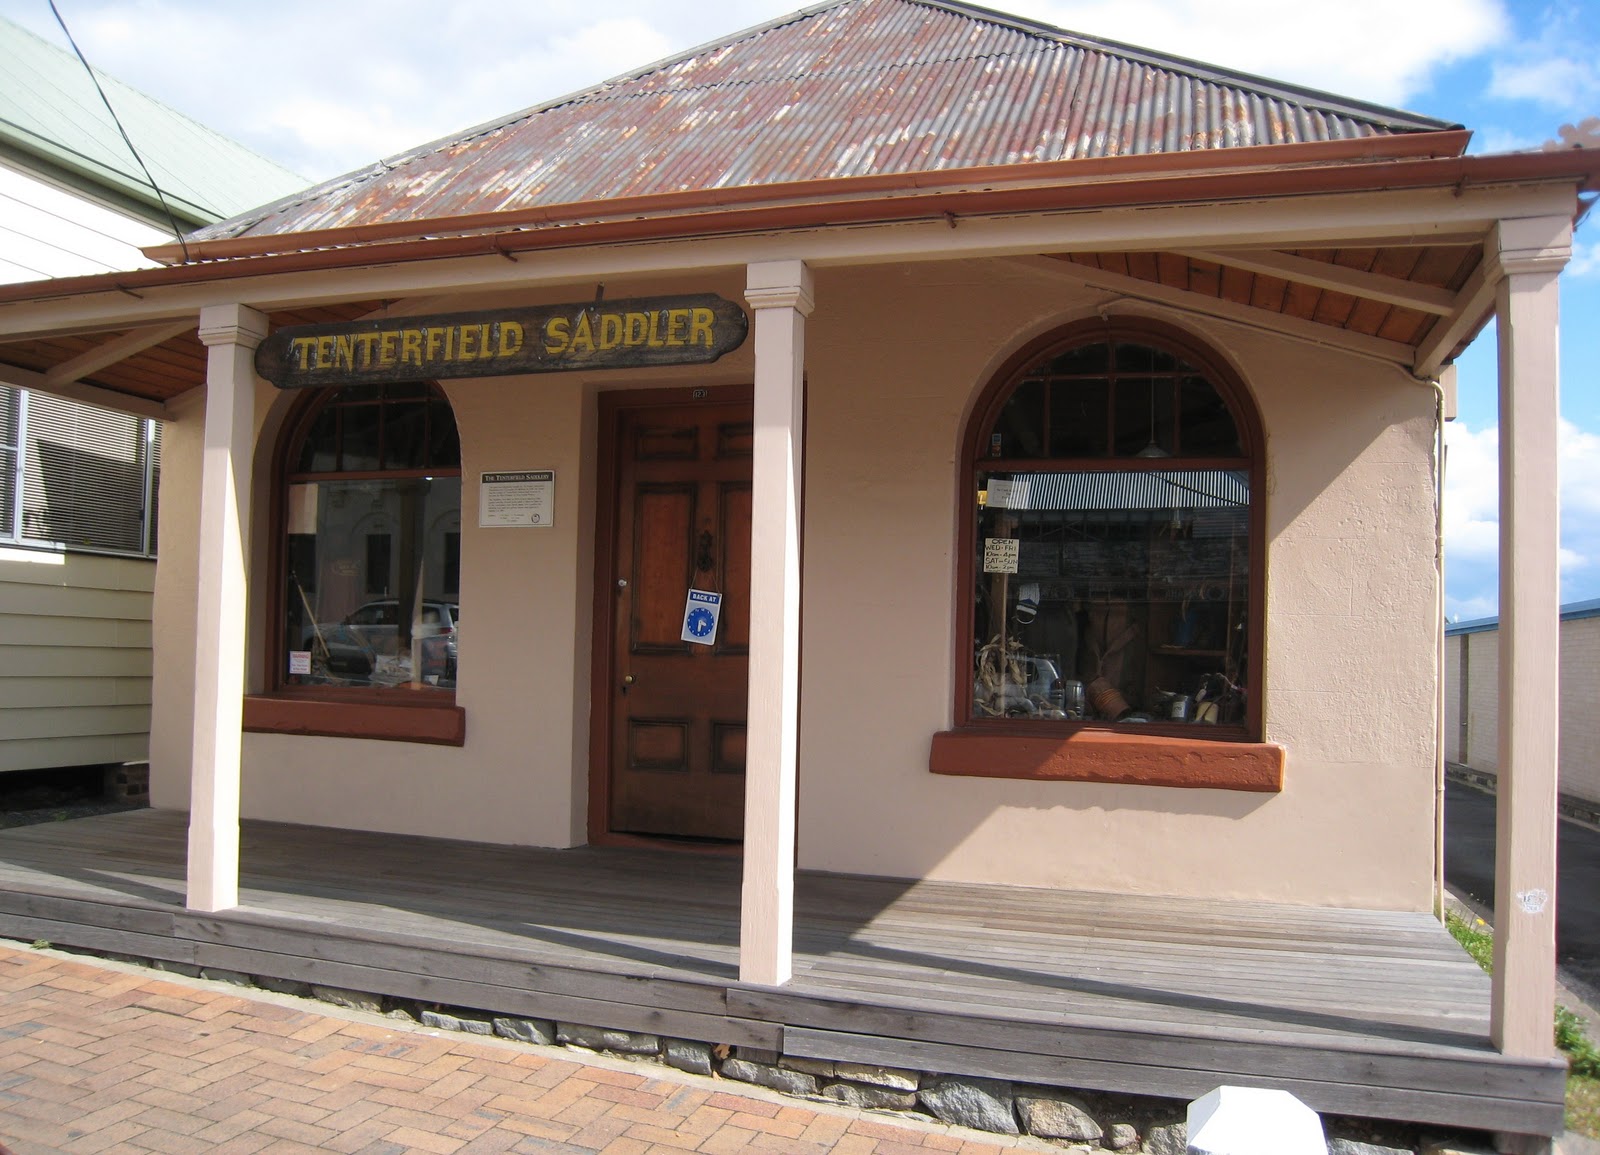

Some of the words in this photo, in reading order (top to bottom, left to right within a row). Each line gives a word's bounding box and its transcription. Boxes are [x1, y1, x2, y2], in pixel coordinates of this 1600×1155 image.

[294, 321, 523, 371] TENTERFIELD
[545, 307, 715, 354] SADDLER
[692, 593, 708, 601] BACK
